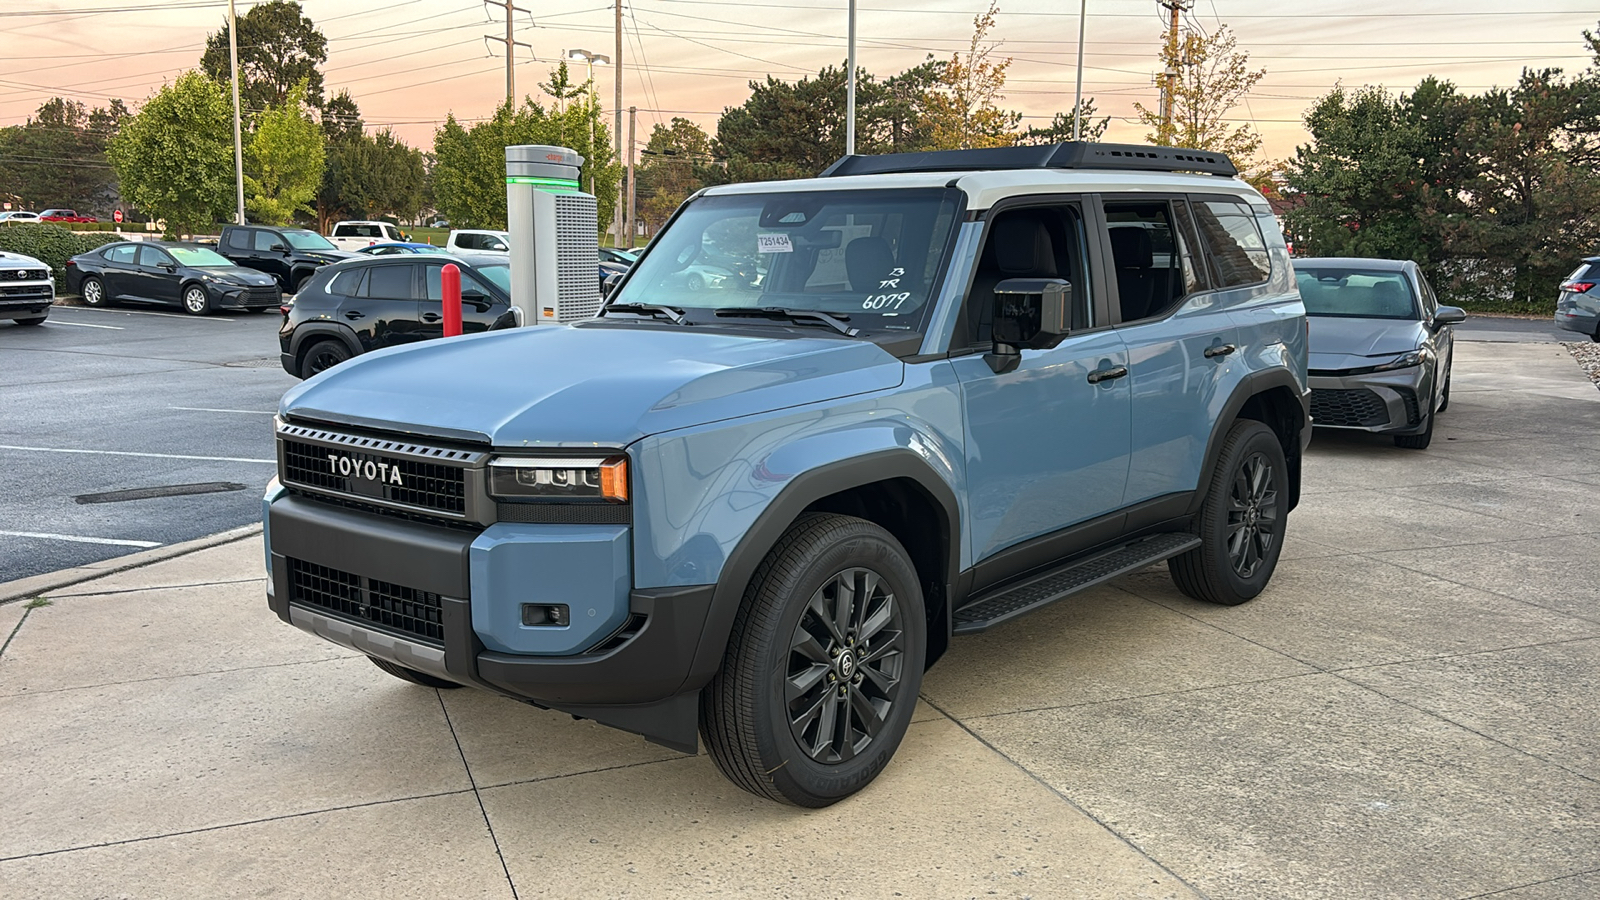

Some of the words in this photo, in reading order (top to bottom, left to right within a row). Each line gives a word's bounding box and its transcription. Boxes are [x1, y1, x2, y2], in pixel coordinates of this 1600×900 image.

[759, 236, 789, 246] T251434
[862, 292, 911, 310] 6079
[328, 454, 403, 485] TOYOTA
